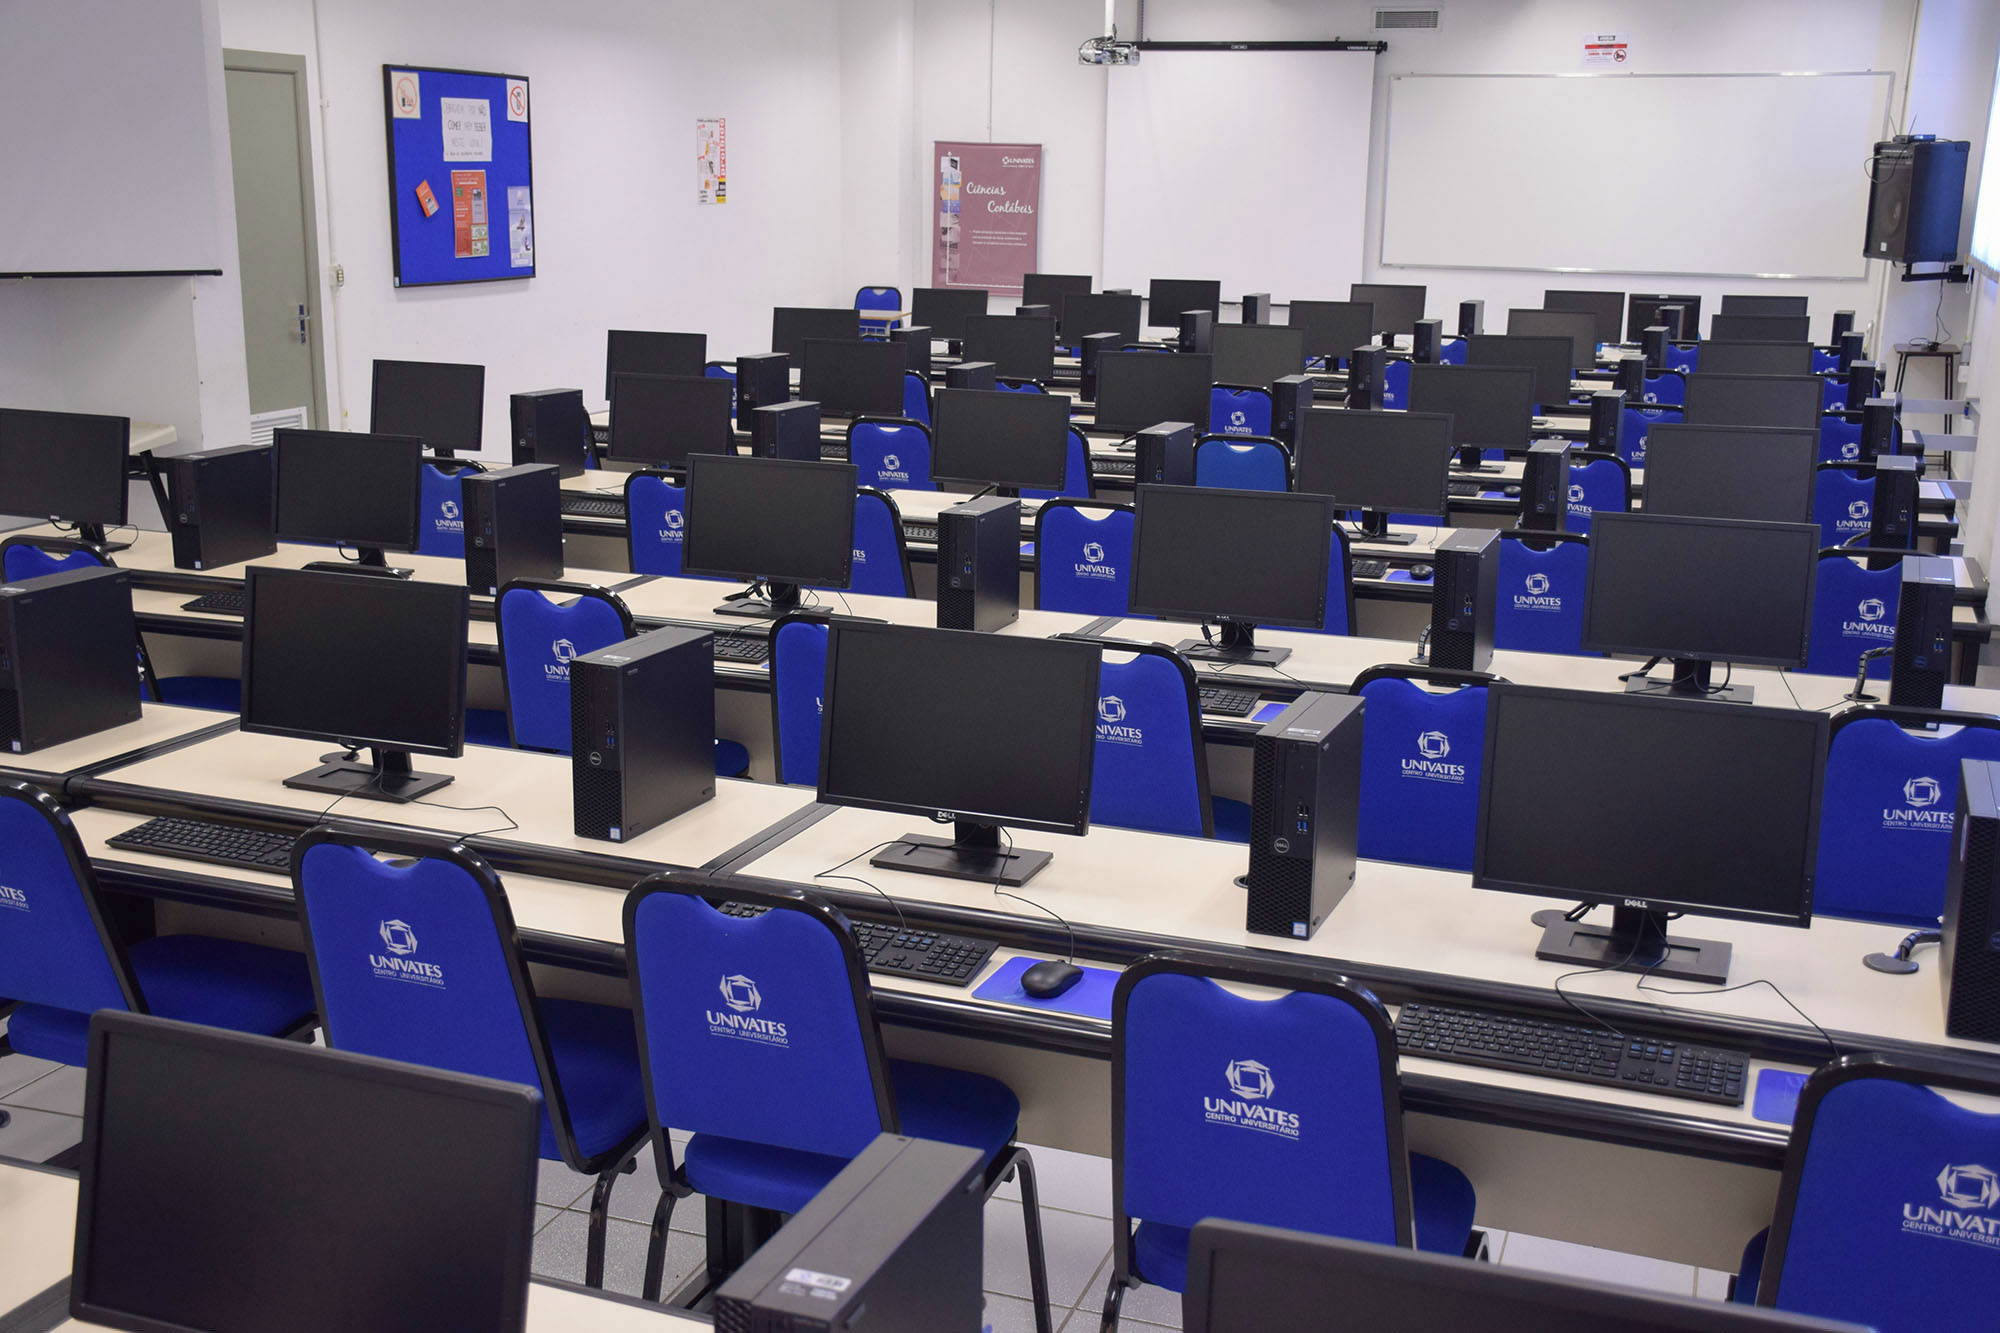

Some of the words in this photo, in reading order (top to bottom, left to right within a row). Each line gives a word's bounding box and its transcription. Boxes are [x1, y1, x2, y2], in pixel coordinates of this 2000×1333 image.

[966, 182, 1007, 196] Ciências
[987, 200, 1034, 215] Contábeis
[1567, 503, 1592, 513] IVATES
[1074, 563, 1116, 576] UNIVATES
[1514, 595, 1561, 606] UNIVATES
[1843, 621, 1895, 635] UNIVATES
[544, 663, 570, 676] UNIV
[1096, 724, 1143, 739] NIVATES
[1401, 759, 1465, 776] UNIVATES
[369, 954, 443, 978] UNIVATES
[373, 967, 397, 977] CENTRO
[706, 1010, 787, 1037] UNIVATES
[709, 1025, 736, 1035] CENTRO
[1204, 1096, 1300, 1128] UNIVATES
[1205, 1112, 1237, 1123] CENTRO
[1240, 1117, 1300, 1136] UNIVERSITÁRIO
[1903, 1203, 2000, 1235] UNIVAT
[1902, 1219, 1943, 1233] CENTRO
[1949, 1228, 2000, 1246] UNIVERSIT
